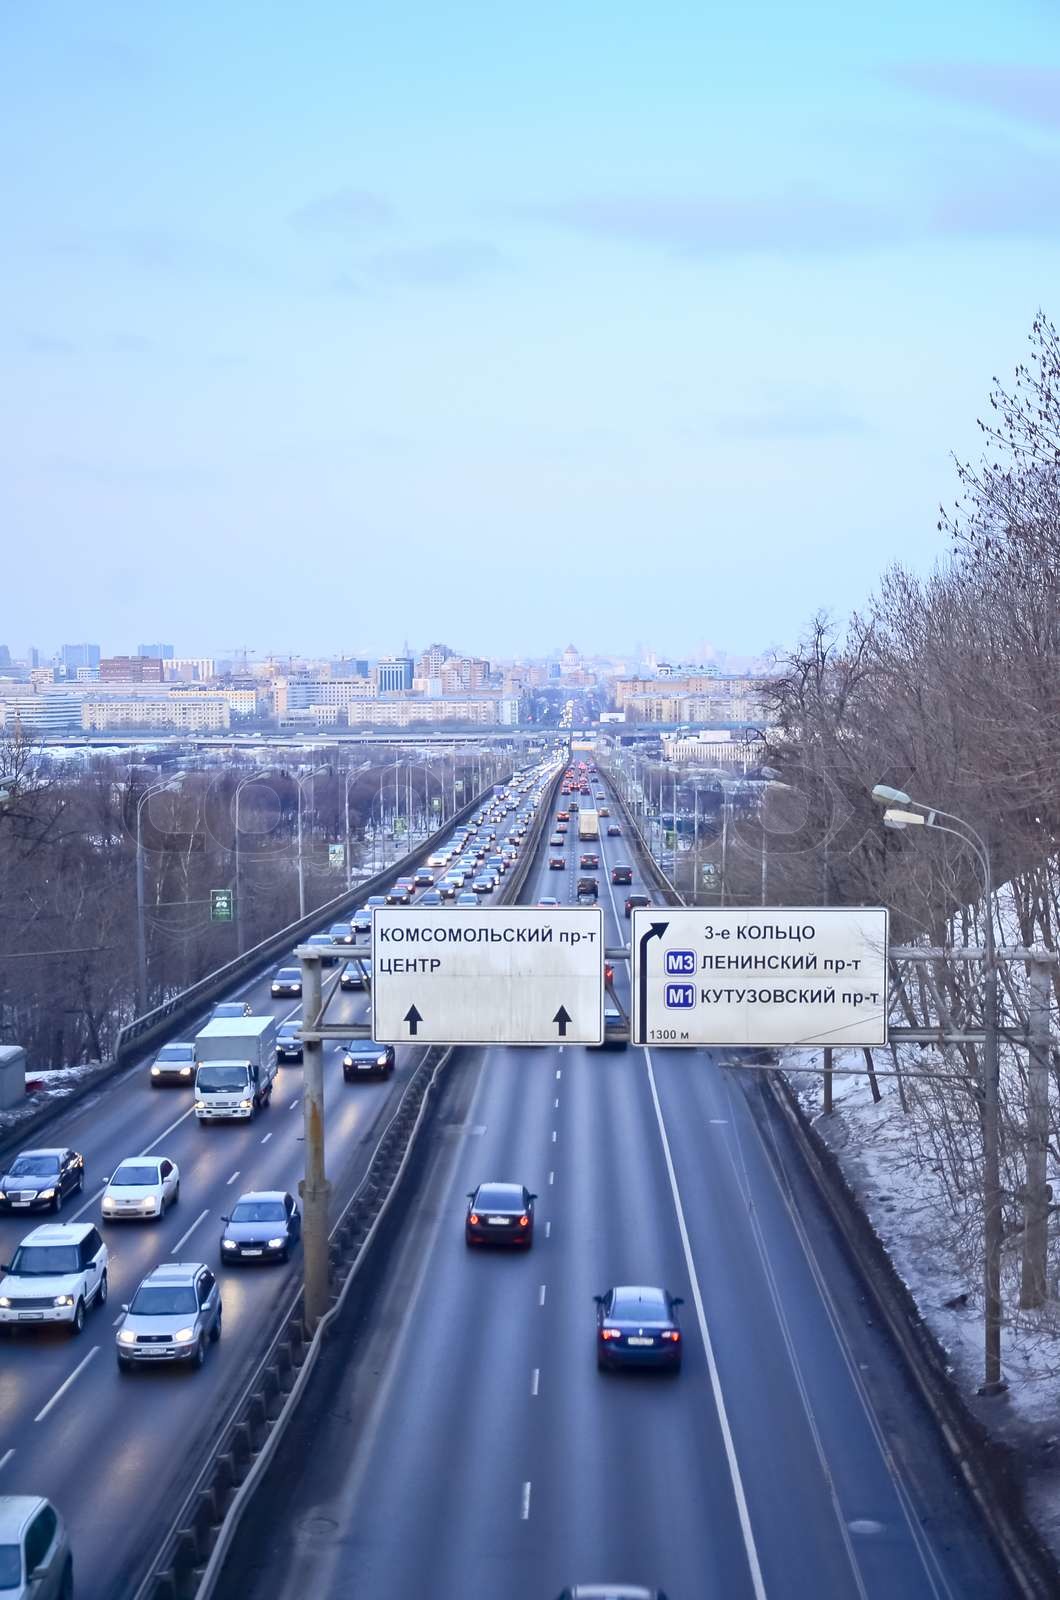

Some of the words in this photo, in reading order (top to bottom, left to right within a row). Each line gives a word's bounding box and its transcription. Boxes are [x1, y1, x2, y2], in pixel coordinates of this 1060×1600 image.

[380, 925, 553, 943] КОМСОМОЛЬСКИЙ
[559, 930, 597, 946] пр-т
[704, 925, 731, 940] 3-е
[736, 925, 816, 943] КОЛЬЦО
[379, 958, 441, 976] ЦЕНТР
[668, 955, 694, 971] М3
[700, 953, 818, 970] ЛЕНИНСКИЙ
[823, 959, 862, 974] пр-т
[669, 989, 693, 1004] М1
[700, 987, 836, 1004] КУТУЗОВСКИЙ
[841, 992, 880, 1008] пр-т
[649, 1029, 677, 1040] 1300
[680, 1031, 689, 1040] м
